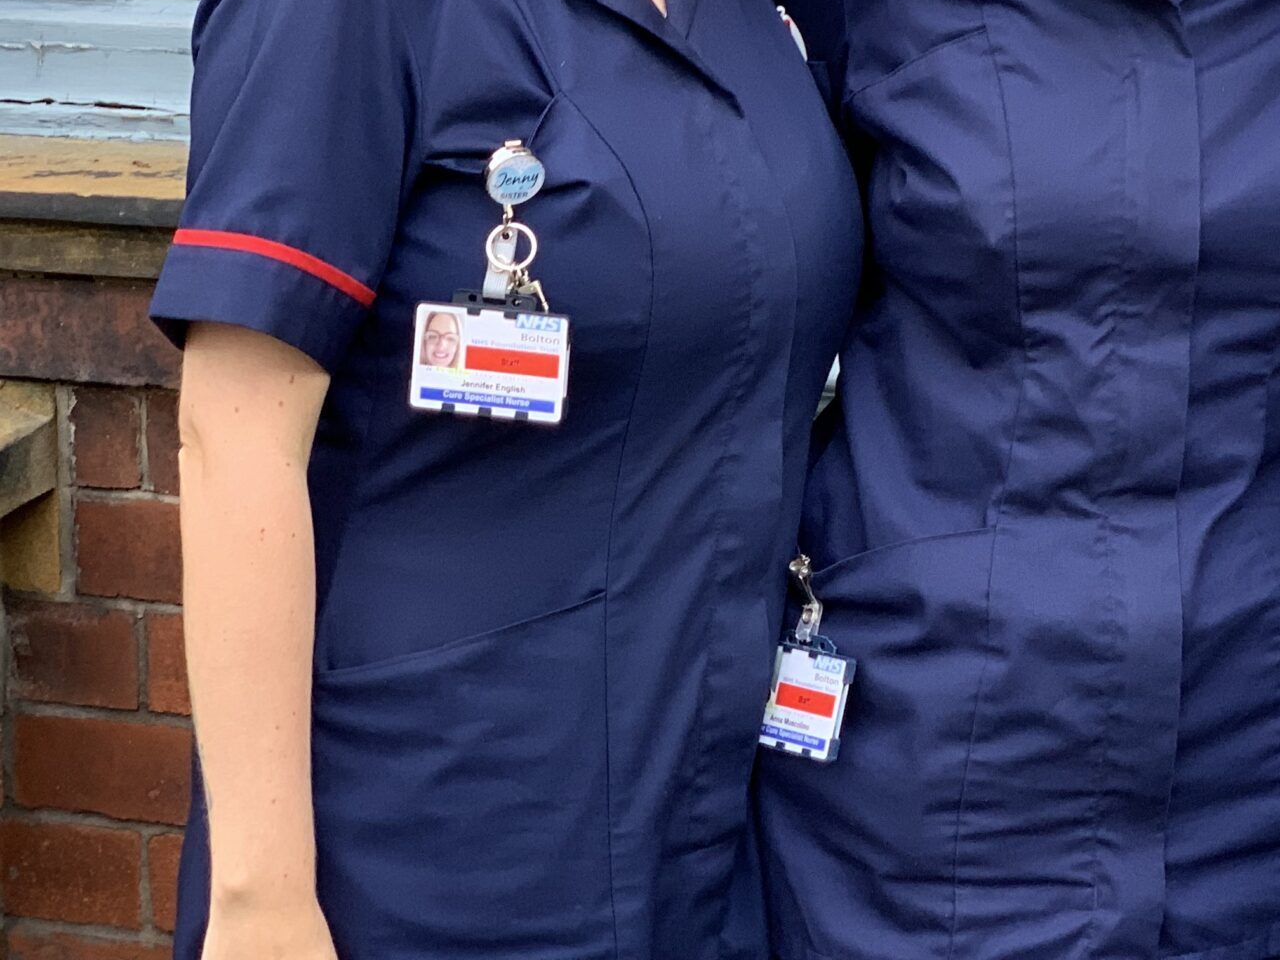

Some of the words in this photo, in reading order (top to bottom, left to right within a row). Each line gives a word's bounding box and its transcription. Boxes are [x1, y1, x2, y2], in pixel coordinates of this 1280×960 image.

[495, 172, 540, 189] Jenny
[516, 315, 560, 331] NHS
[520, 333, 561, 345] Bolton
[461, 379, 494, 391] Jennifer
[495, 383, 526, 394] English
[505, 397, 531, 408] Nurse
[814, 658, 842, 673] NHS
